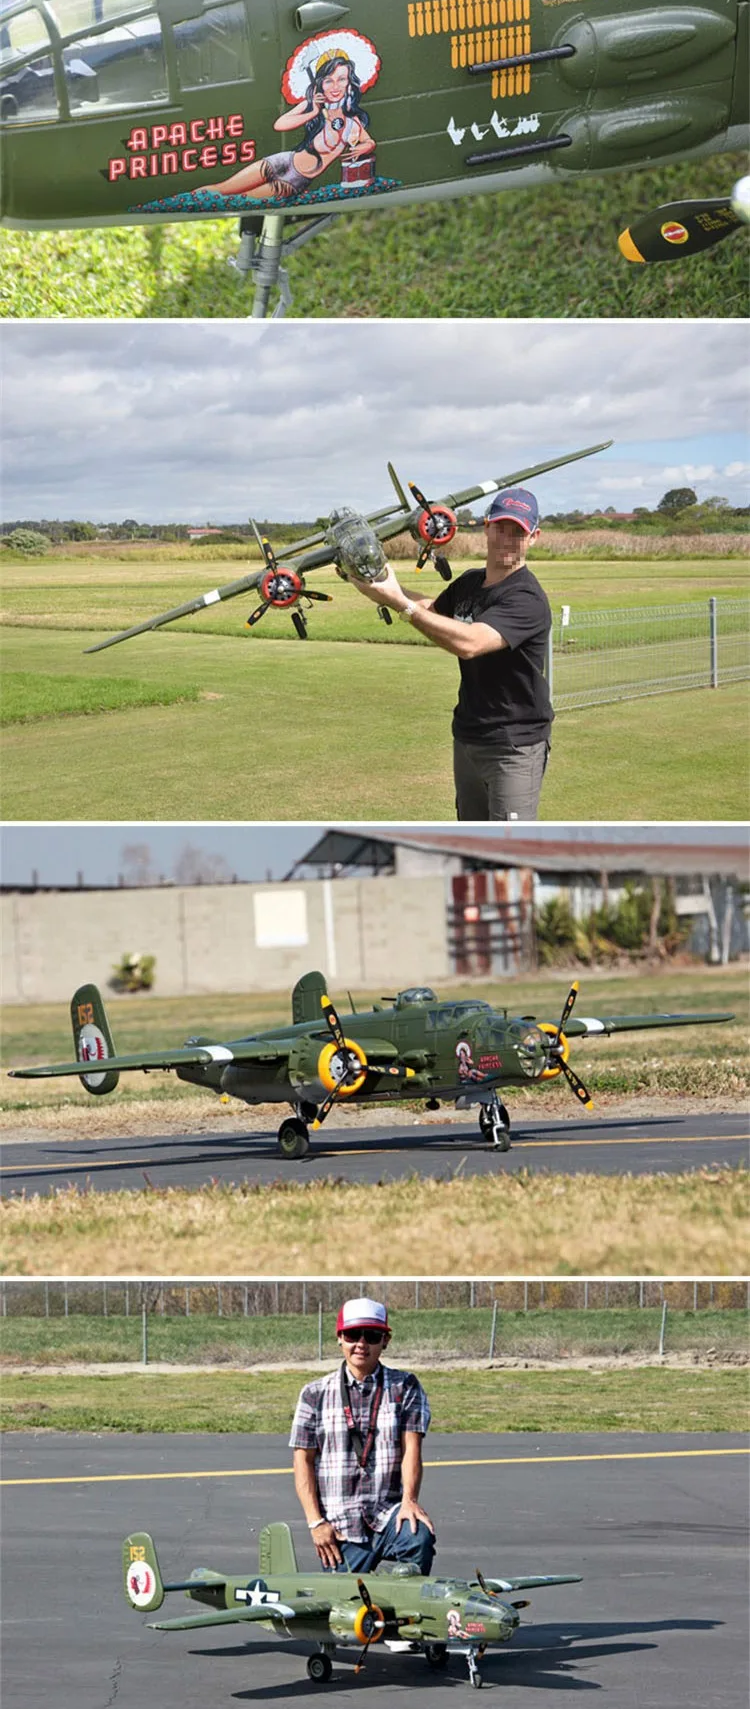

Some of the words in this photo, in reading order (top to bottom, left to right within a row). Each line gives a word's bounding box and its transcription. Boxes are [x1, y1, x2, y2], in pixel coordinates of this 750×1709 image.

[126, 113, 244, 152] APACHE
[108, 140, 255, 182] PRINCESS
[78, 1003, 94, 1025] 152
[129, 1545, 145, 1562] 152
